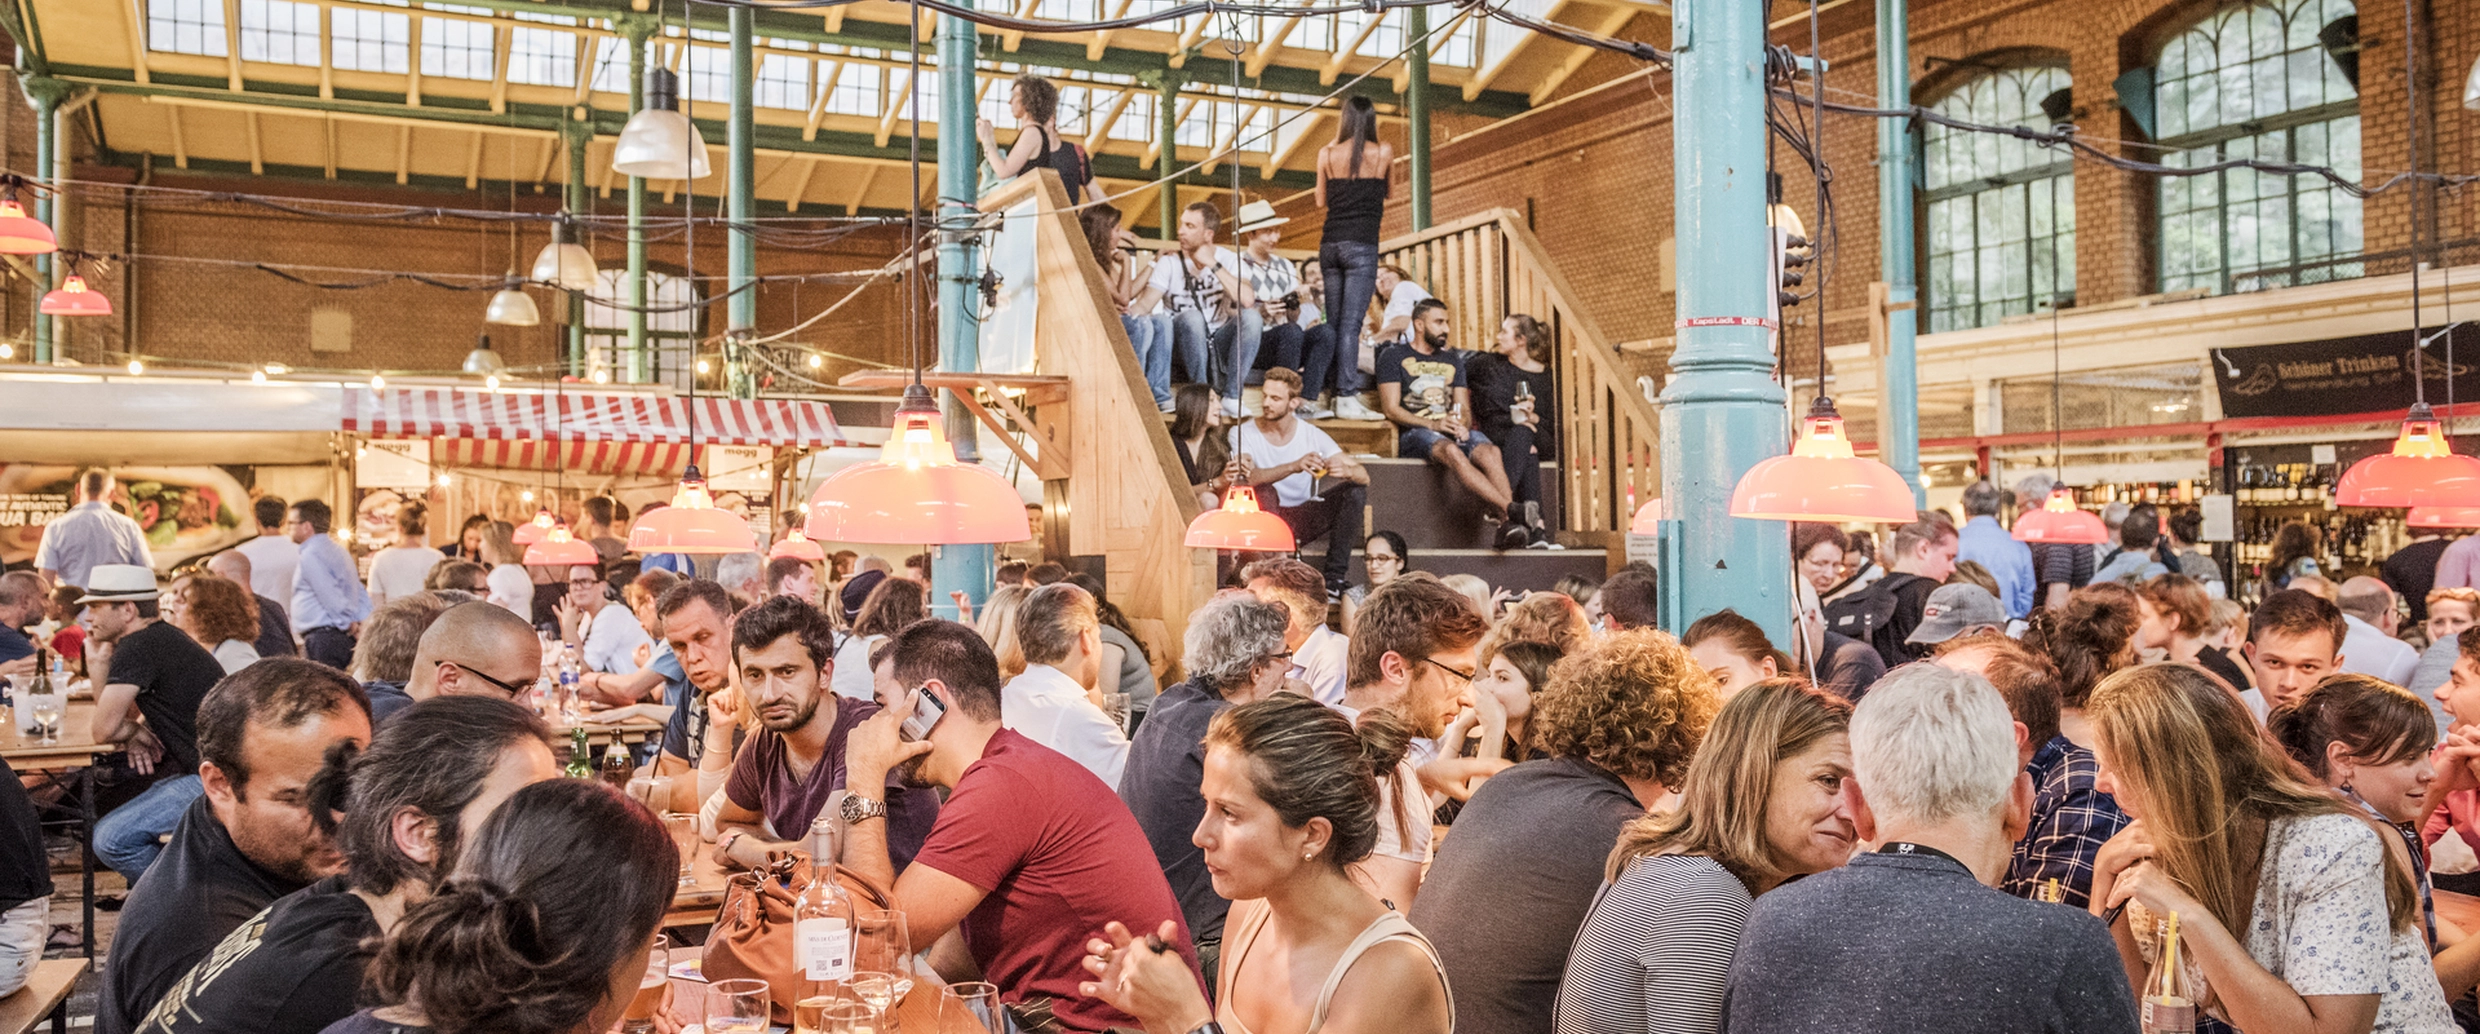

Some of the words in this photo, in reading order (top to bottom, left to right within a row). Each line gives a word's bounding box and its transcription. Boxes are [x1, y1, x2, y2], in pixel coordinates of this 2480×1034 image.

[1742, 317, 1760, 326] DER
[2278, 360, 2333, 379] Schöner
[2337, 353, 2400, 374] Trinken
[724, 448, 758, 458] mogg
